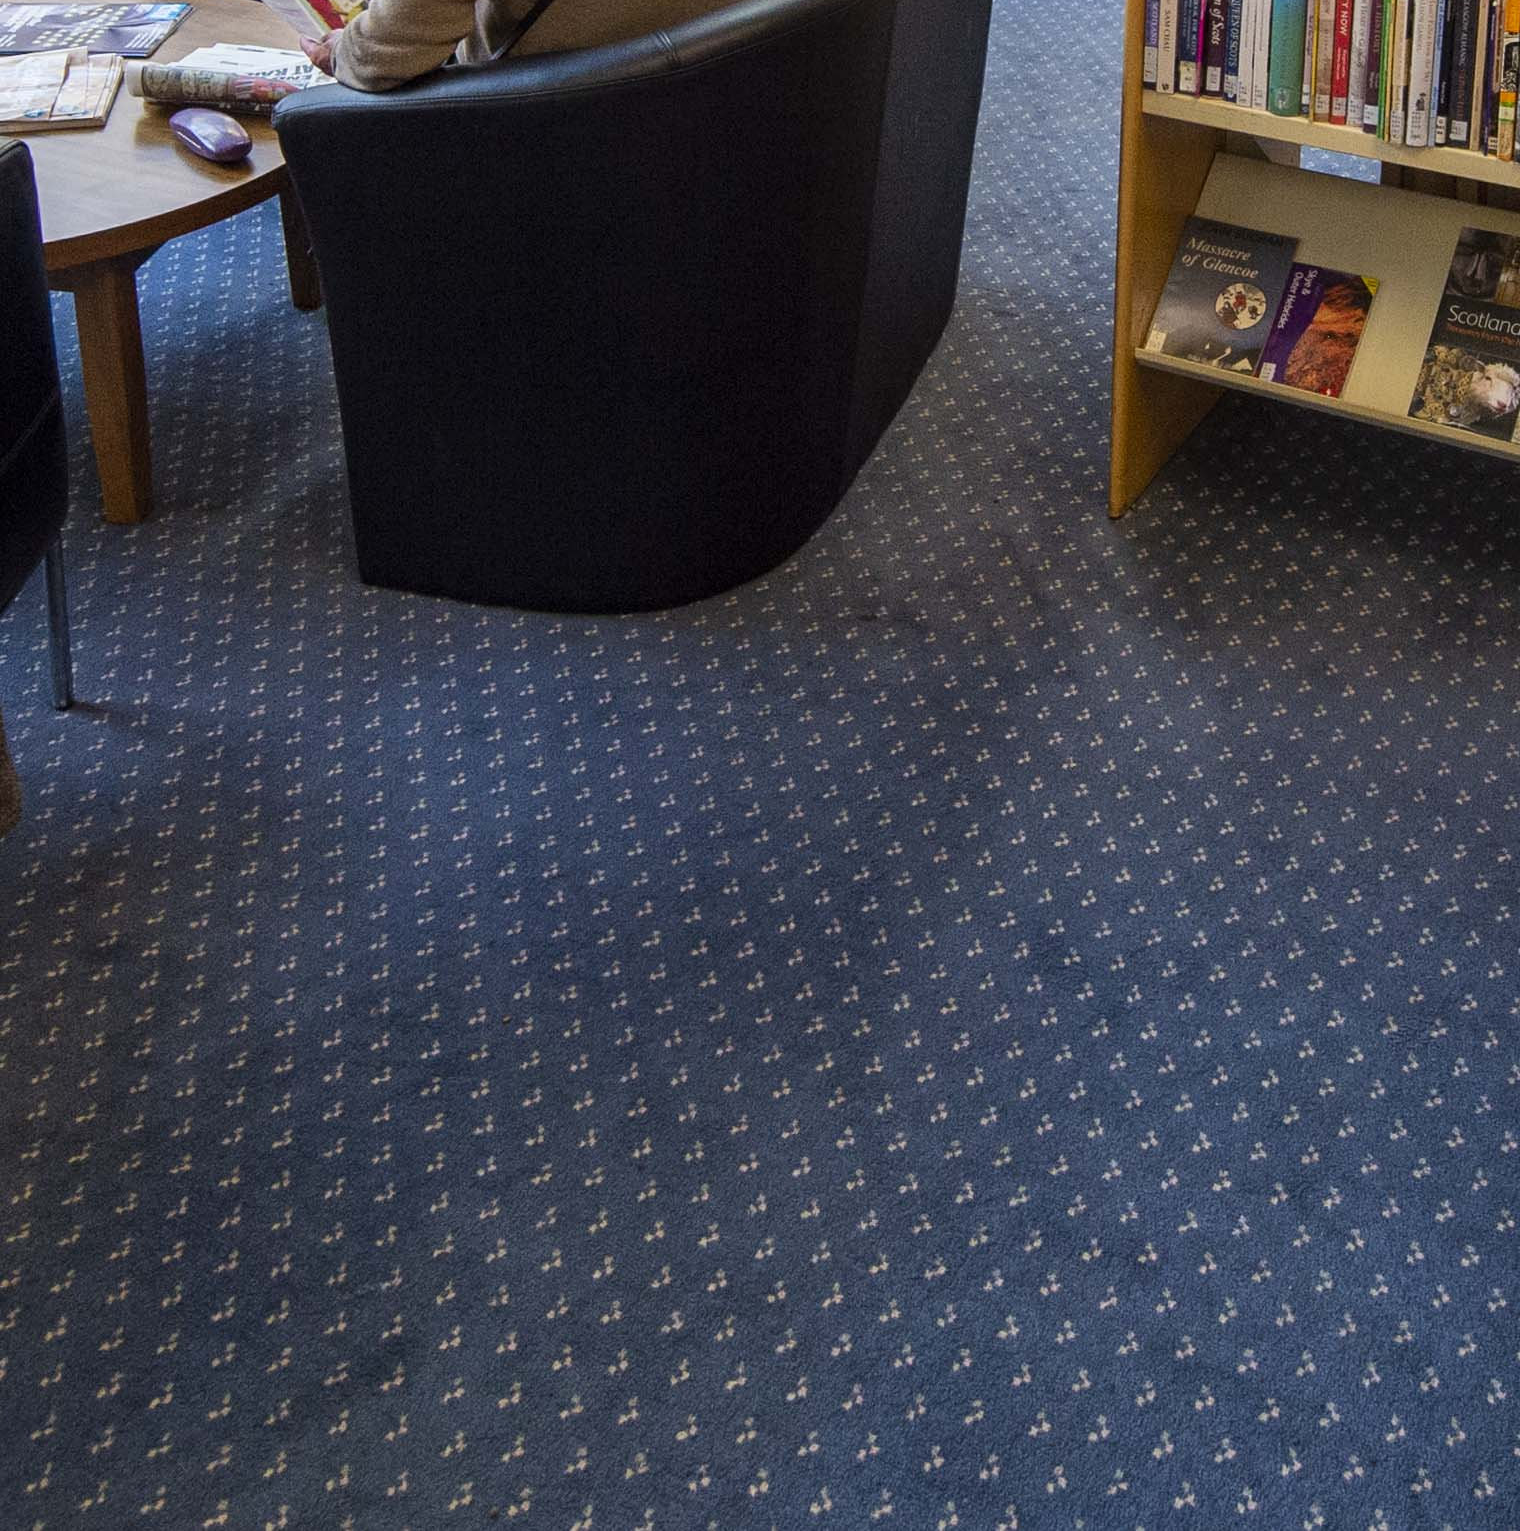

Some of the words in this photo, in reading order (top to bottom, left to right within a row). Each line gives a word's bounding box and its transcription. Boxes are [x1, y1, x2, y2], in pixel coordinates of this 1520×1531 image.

[1211, 8, 1225, 19] of
[1339, 11, 1348, 36] NOW
[1210, 23, 1223, 45] Scots
[1186, 237, 1252, 263] Massacre
[1182, 251, 1198, 268] of
[1202, 255, 1260, 281] Glencoe
